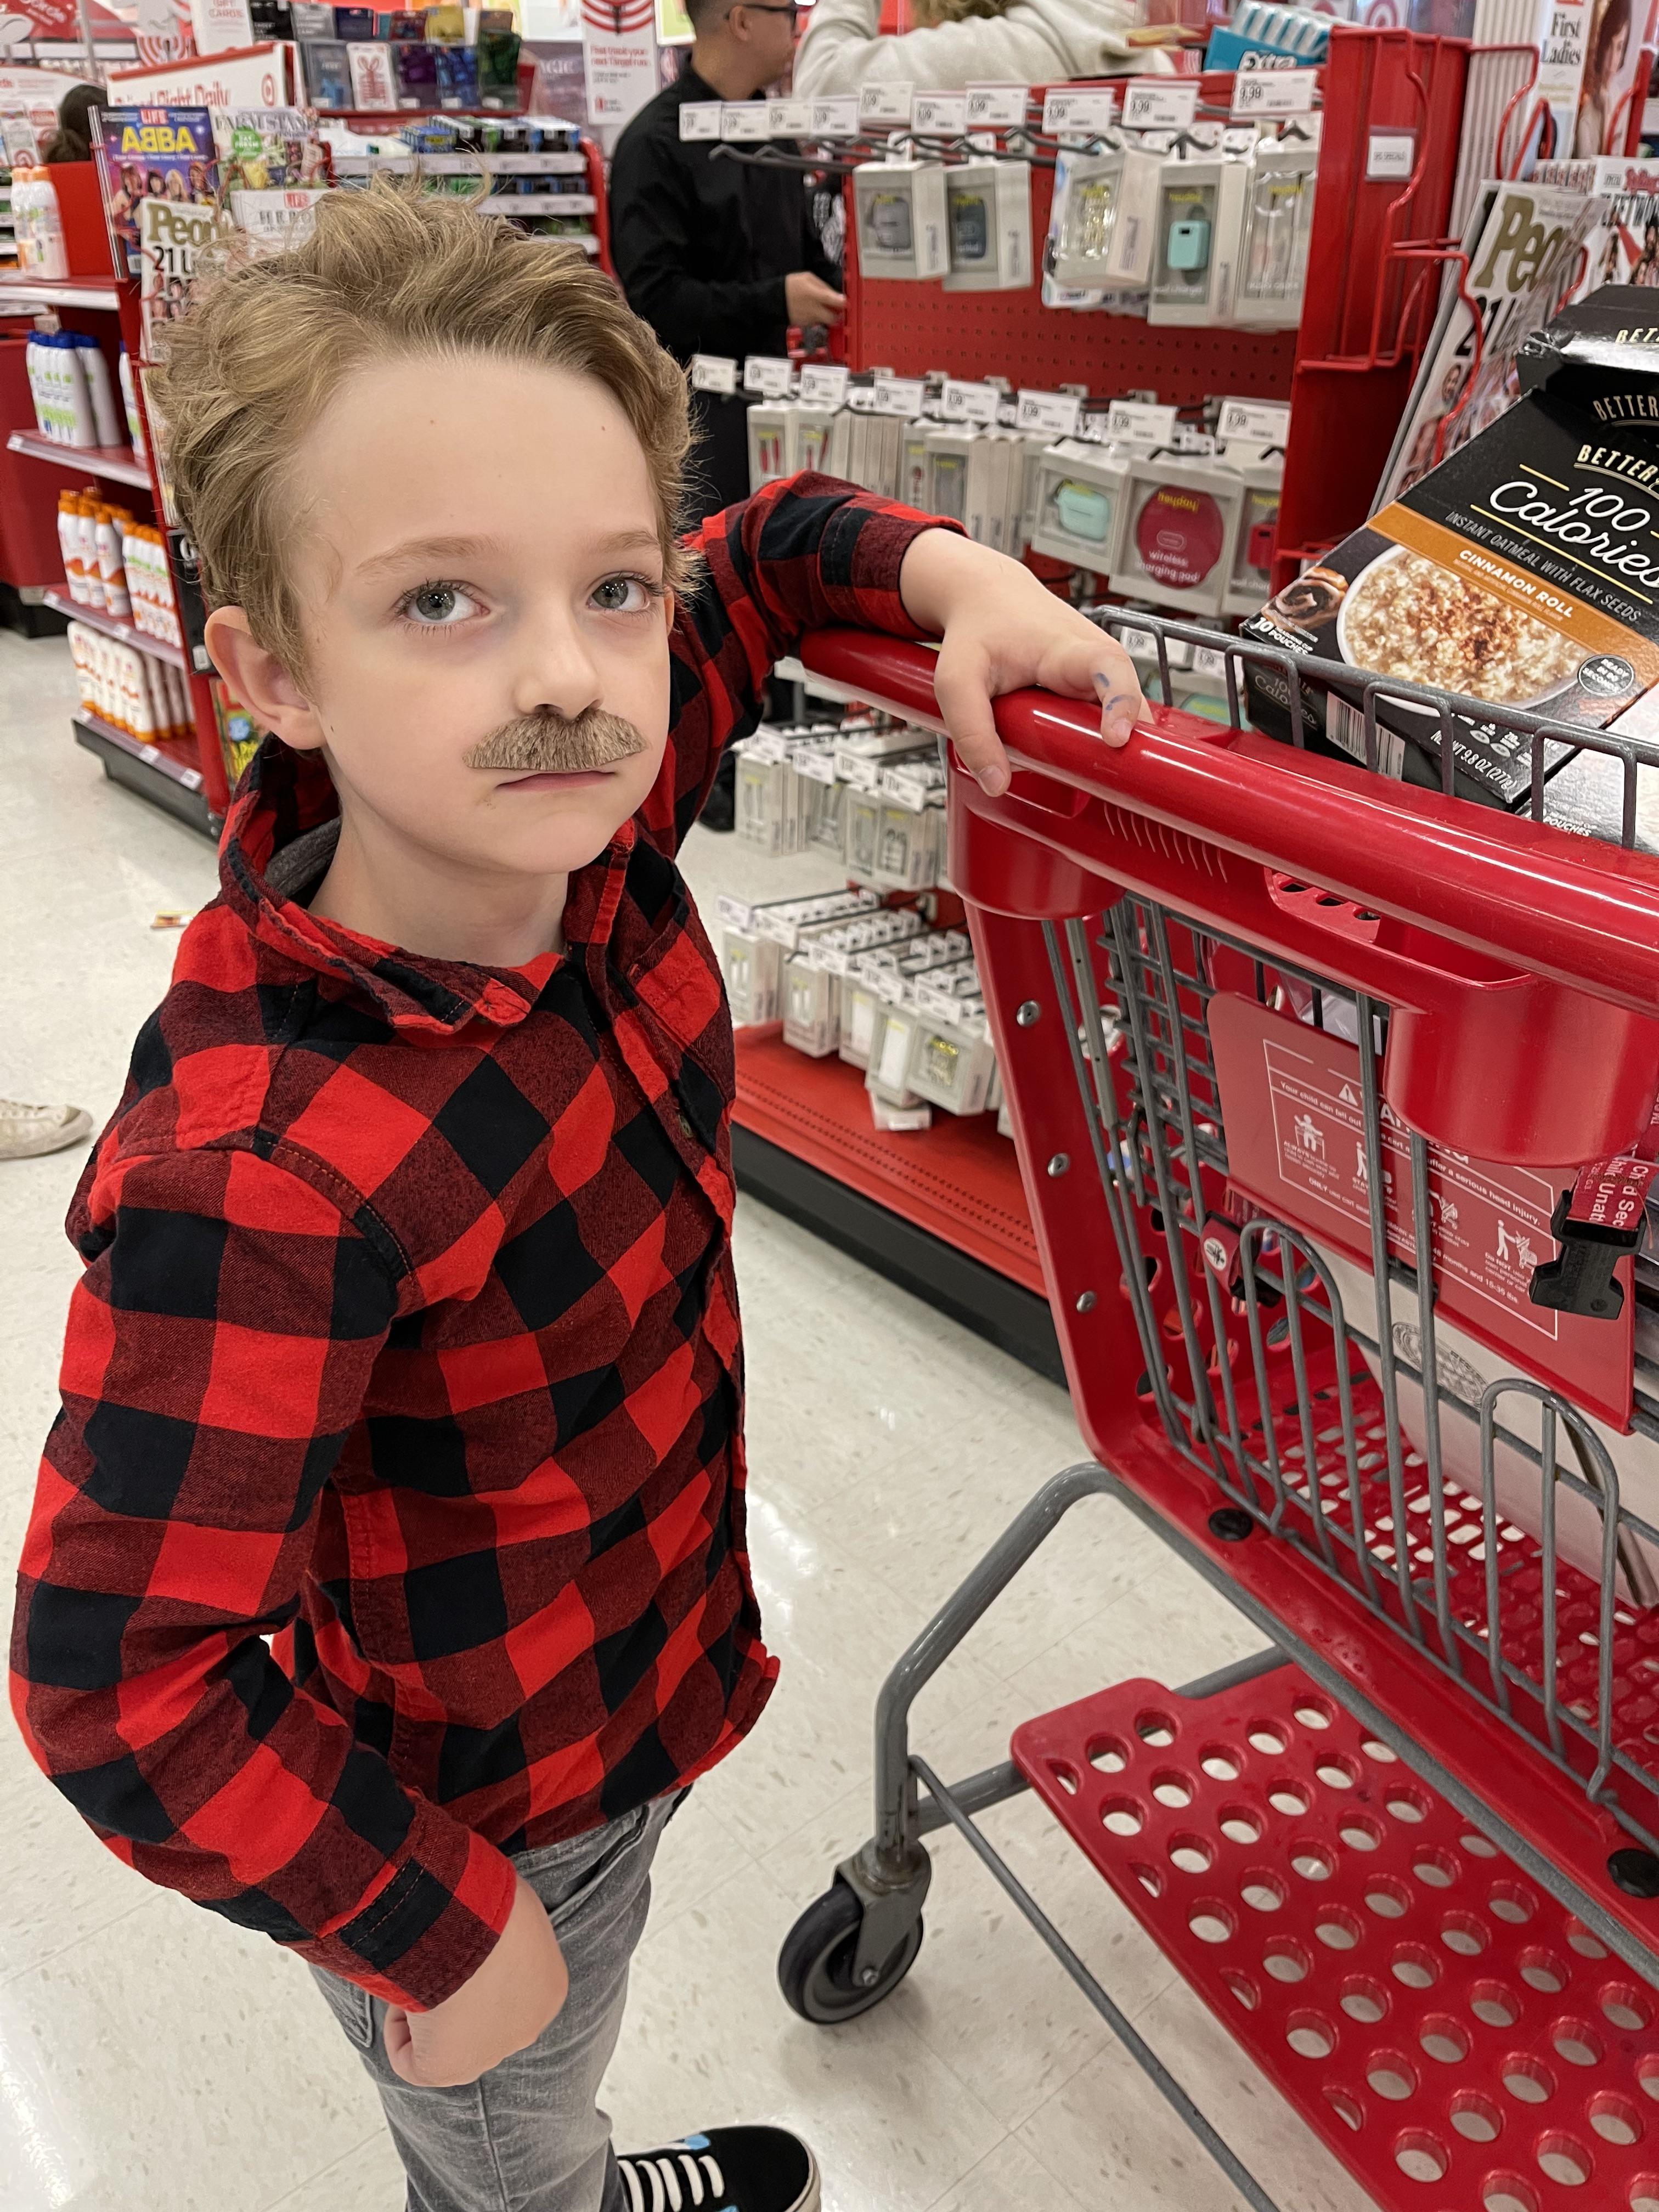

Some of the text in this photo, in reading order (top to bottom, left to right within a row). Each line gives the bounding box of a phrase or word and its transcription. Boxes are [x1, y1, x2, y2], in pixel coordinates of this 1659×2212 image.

[1551, 12, 1581, 38] First
[1541, 38, 1581, 65] Ladies
[121, 126, 198, 154] ABBA
[1615, 328, 1659, 343] BET
[1593, 394, 1658, 421] BETTER
[1577, 444, 1658, 482] BETTER
[1568, 487, 1651, 532] 100
[1489, 481, 1659, 588] Calories
[1444, 510, 1494, 541] INSTANT
[1490, 534, 1542, 567] OATMEAL
[1540, 560, 1573, 583] WITH
[1569, 576, 1603, 601] FLAX
[1600, 594, 1642, 623] SEEDS
[1459, 549, 1537, 595] CINNAMON
[1535, 590, 1574, 618] ROLL
[1250, 617, 1309, 656] 10 POUCHES
[1274, 678, 1291, 697] 10
[1474, 758, 1493, 773] OZ
[1280, 1081, 1299, 1095] Your
[1300, 1091, 1319, 1105] child
[1319, 1101, 1333, 1113] can
[1335, 1108, 1347, 1120] fall
[1348, 1116, 1362, 1128] out
[1387, 1133, 1404, 1149] cart
[1455, 1172, 1488, 1195] serious
[1489, 1190, 1511, 1209] head
[1512, 1203, 1541, 1226] injury.
[1622, 1164, 1649, 1197] Chd
[1589, 1182, 1616, 1222] Unatt
